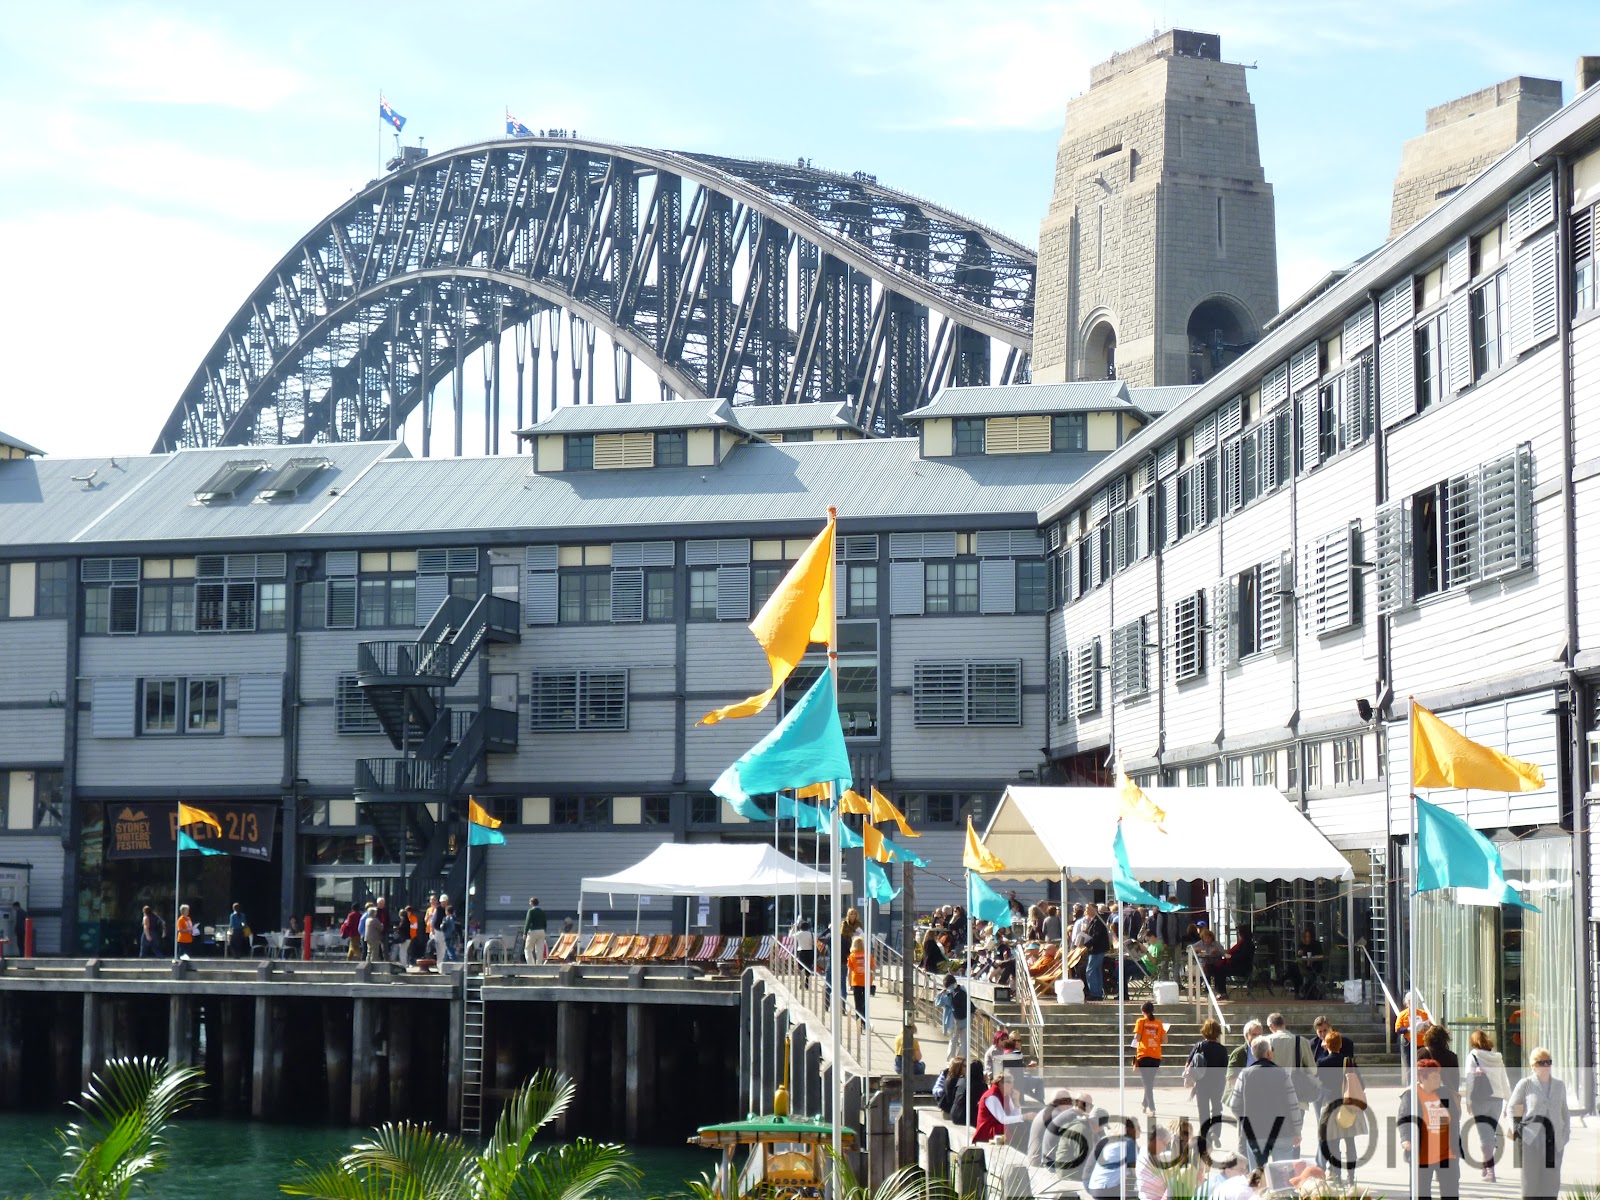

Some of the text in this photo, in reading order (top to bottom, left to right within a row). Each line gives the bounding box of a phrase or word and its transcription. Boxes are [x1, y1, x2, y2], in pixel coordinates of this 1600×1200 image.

[115, 822, 150, 833] SYDNEY
[226, 812, 259, 842] 2/3
[116, 841, 152, 850] FESTIVAL
